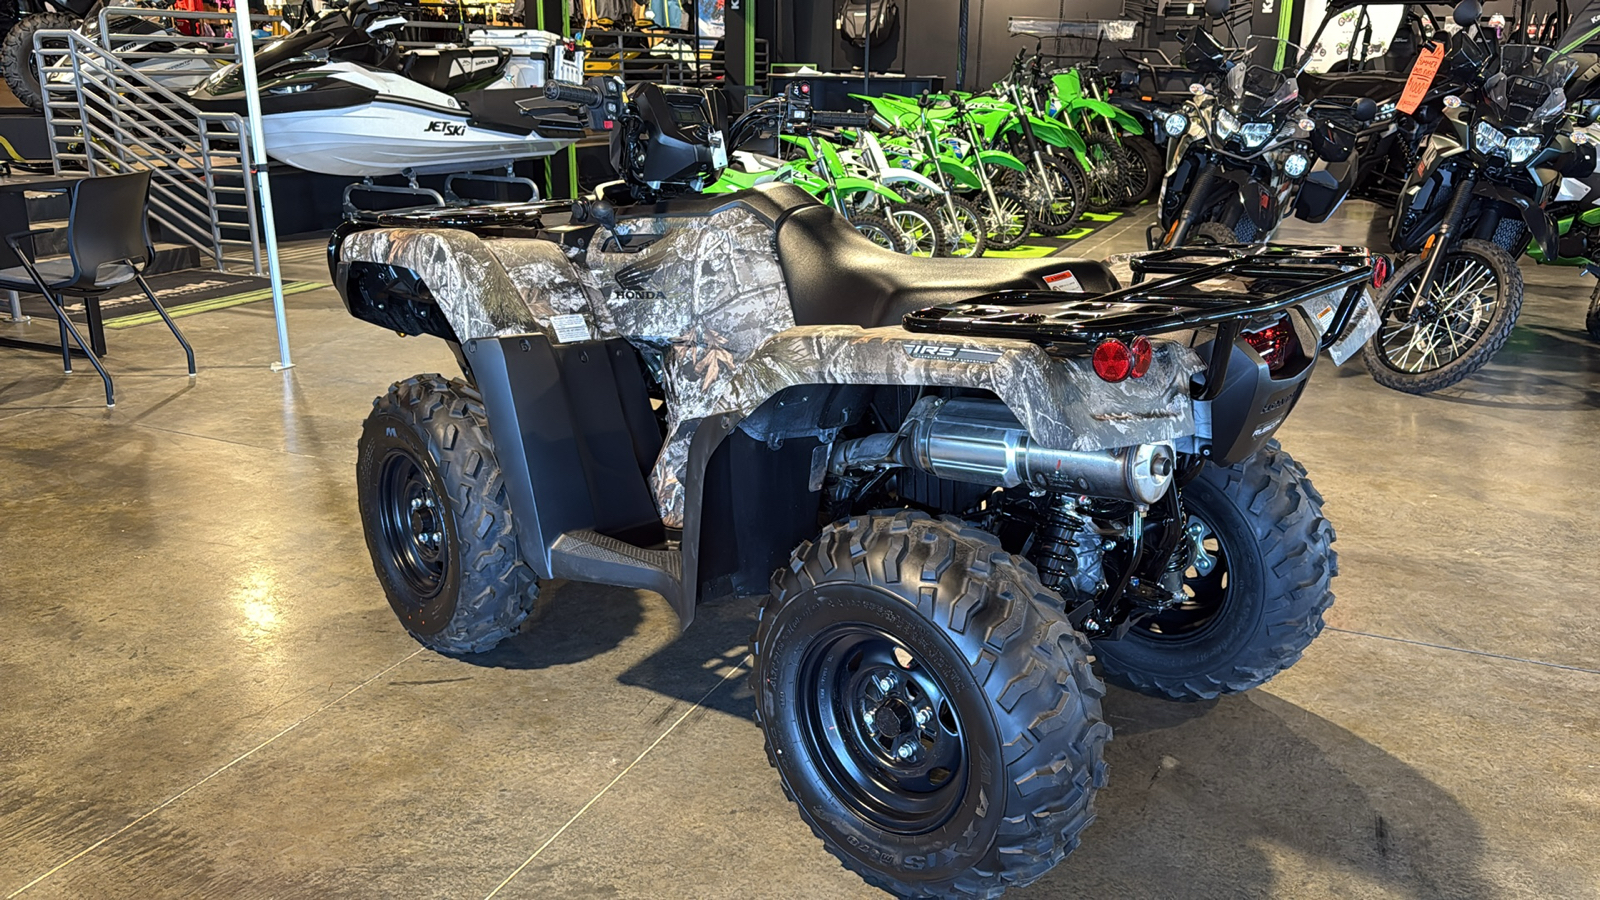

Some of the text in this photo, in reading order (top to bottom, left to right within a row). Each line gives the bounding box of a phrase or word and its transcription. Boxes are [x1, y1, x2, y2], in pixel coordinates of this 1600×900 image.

[424, 121, 450, 132] JET
[614, 290, 667, 300] HONDA
[913, 345, 958, 357] IRS
